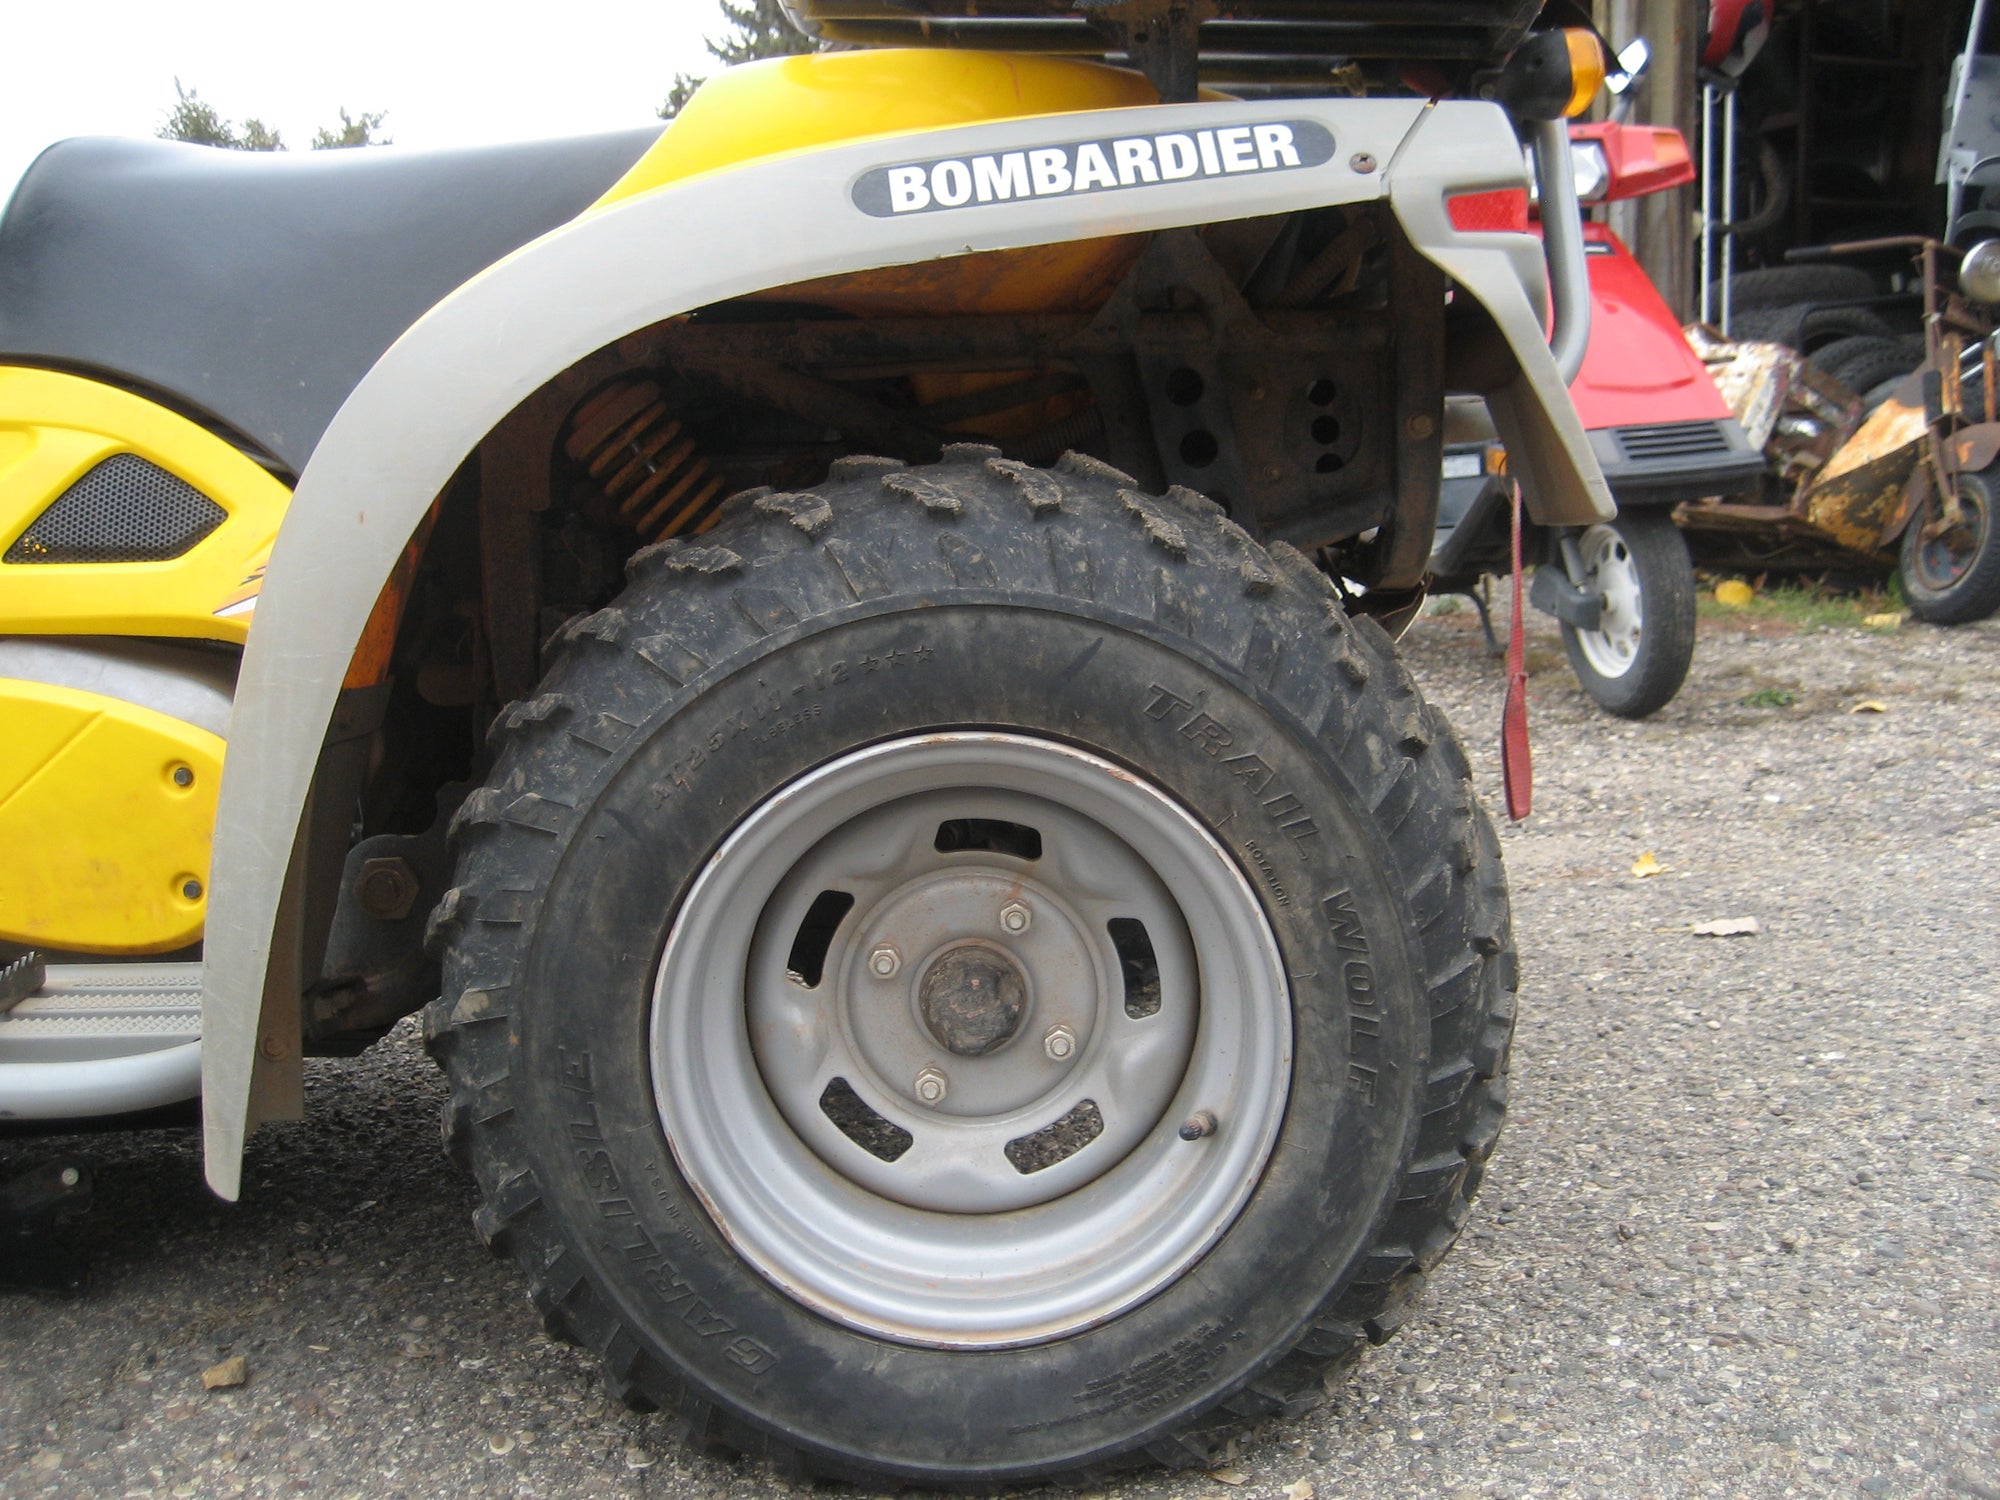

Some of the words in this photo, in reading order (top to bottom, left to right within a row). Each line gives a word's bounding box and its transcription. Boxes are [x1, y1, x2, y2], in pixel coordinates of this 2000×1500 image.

[888, 124, 1301, 213] BOMBARDIER
[1141, 682, 1319, 861] TRAIL
[1322, 887, 1381, 1110] WOLF
[558, 1046, 779, 1375] CARLISLE
